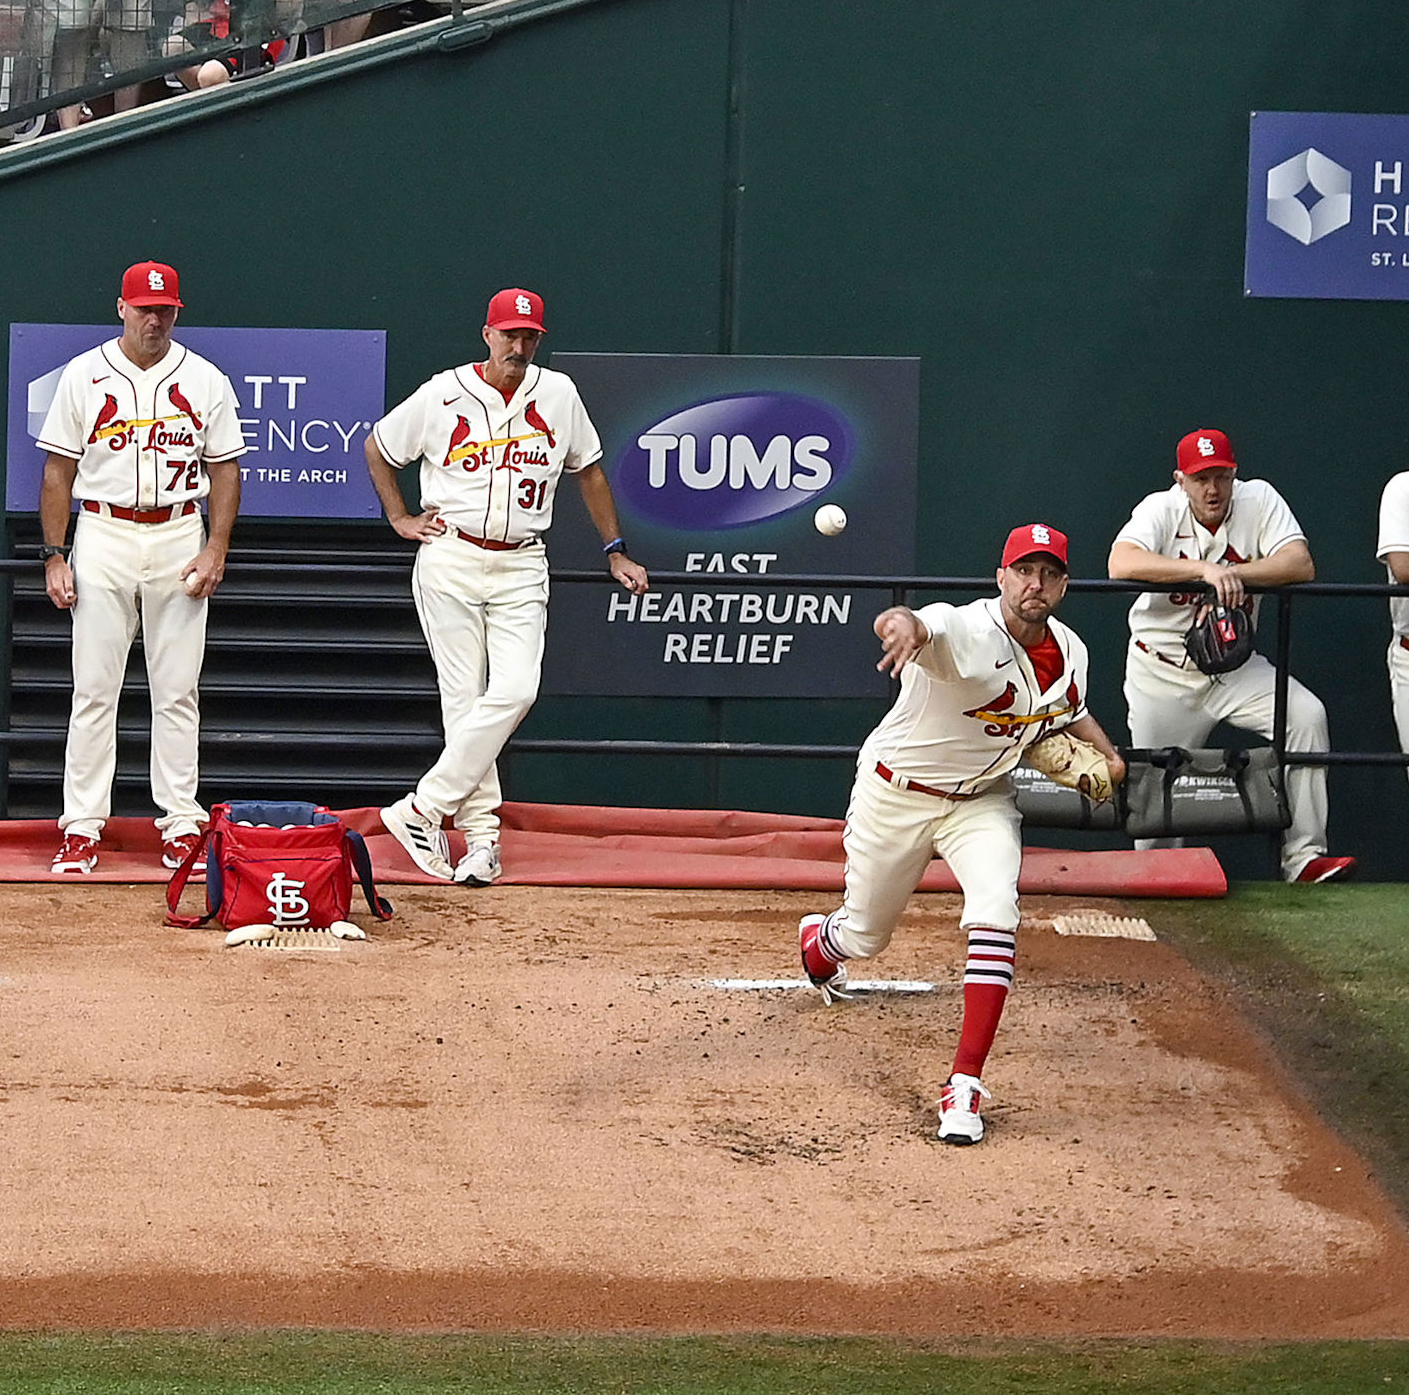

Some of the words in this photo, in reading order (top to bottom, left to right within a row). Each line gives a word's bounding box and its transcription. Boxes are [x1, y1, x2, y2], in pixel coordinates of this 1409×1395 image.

[1371, 252, 1396, 268] ST.
[142, 419, 195, 454] Louis
[495, 439, 550, 474] Louis
[637, 434, 833, 492] TUMS
[166, 460, 199, 492] 72
[257, 468, 291, 483] THE
[297, 469, 348, 483] ARCH
[517, 477, 548, 510] 31
[685, 553, 778, 575] FAST
[607, 591, 852, 625] HEARTBURN
[663, 633, 795, 665] RELIEF
